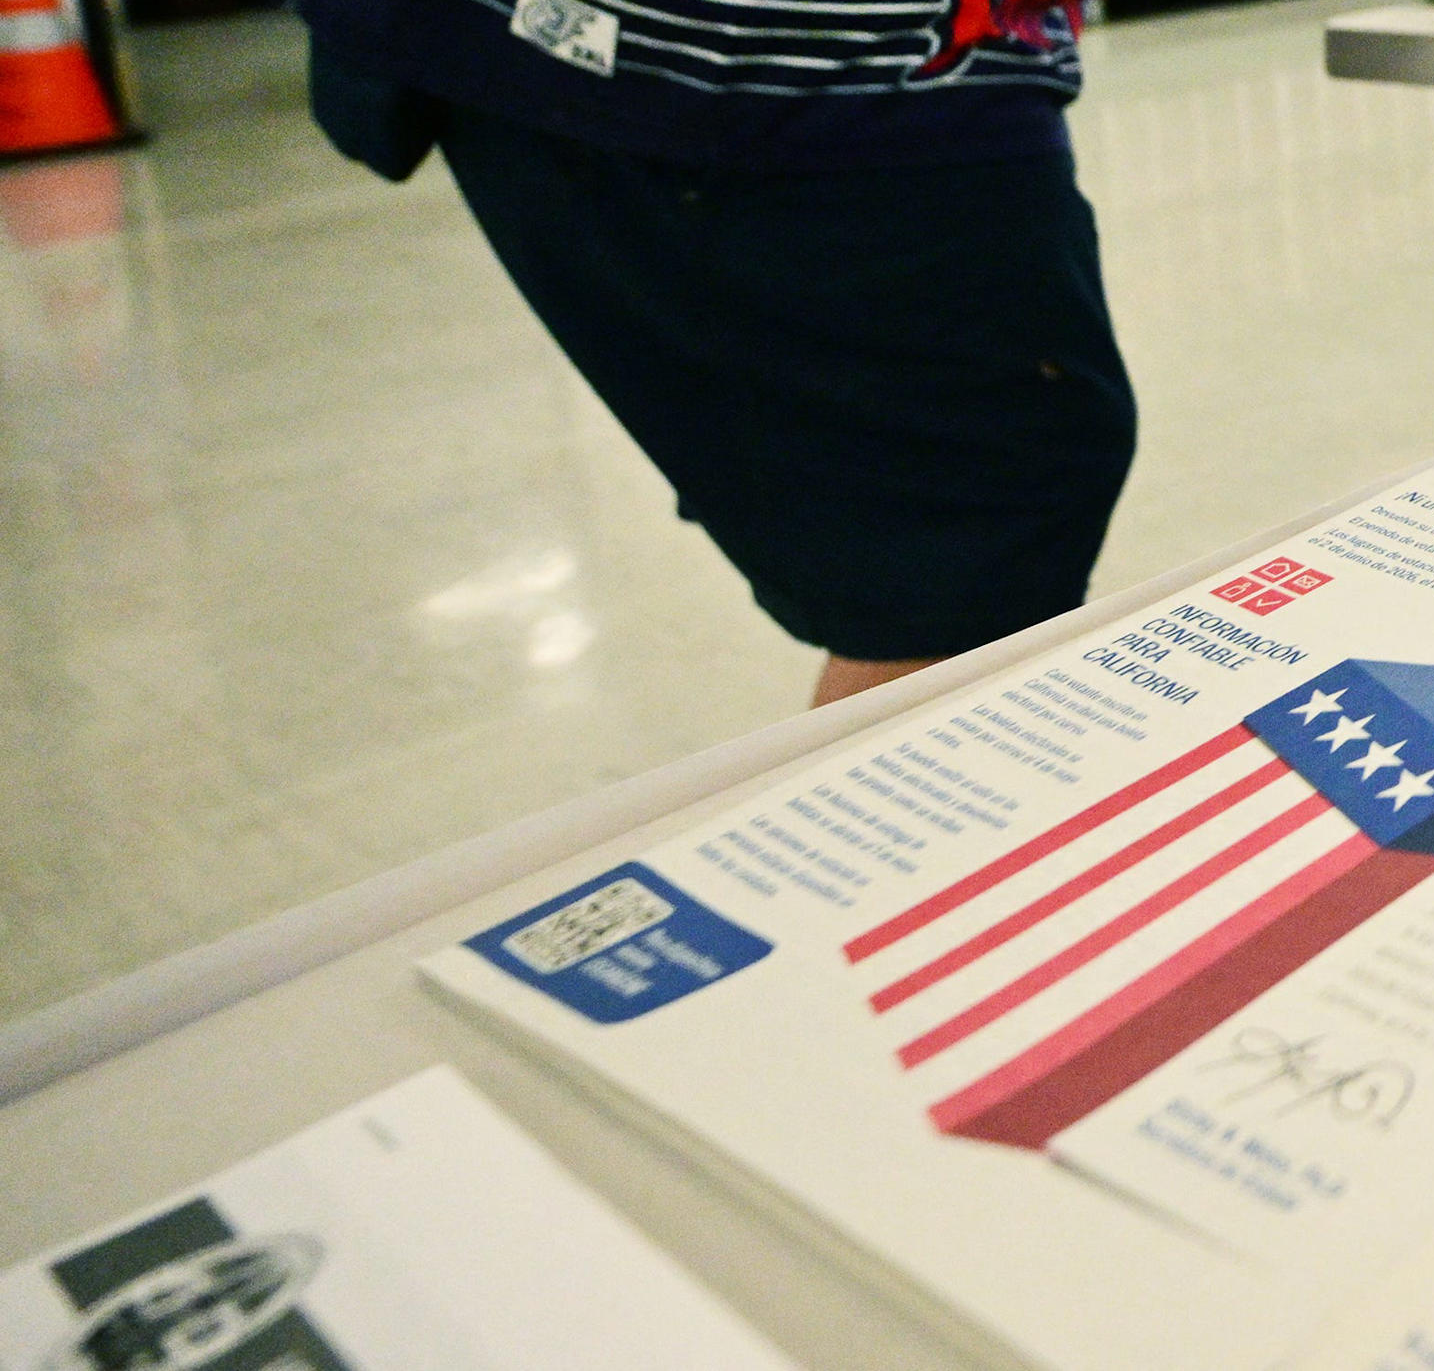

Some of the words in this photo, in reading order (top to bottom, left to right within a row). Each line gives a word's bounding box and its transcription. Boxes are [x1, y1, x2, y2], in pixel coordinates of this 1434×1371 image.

[1349, 517, 1364, 525] El
[1399, 535, 1414, 545] de
[1371, 506, 1417, 527] Devuelva
[1417, 523, 1430, 532] su
[1112, 633, 1171, 663] PARA
[1142, 618, 1255, 671] CONFIABLE
[1170, 604, 1309, 665] INFORMACIÓN
[1083, 647, 1200, 705] CALIFORNIA
